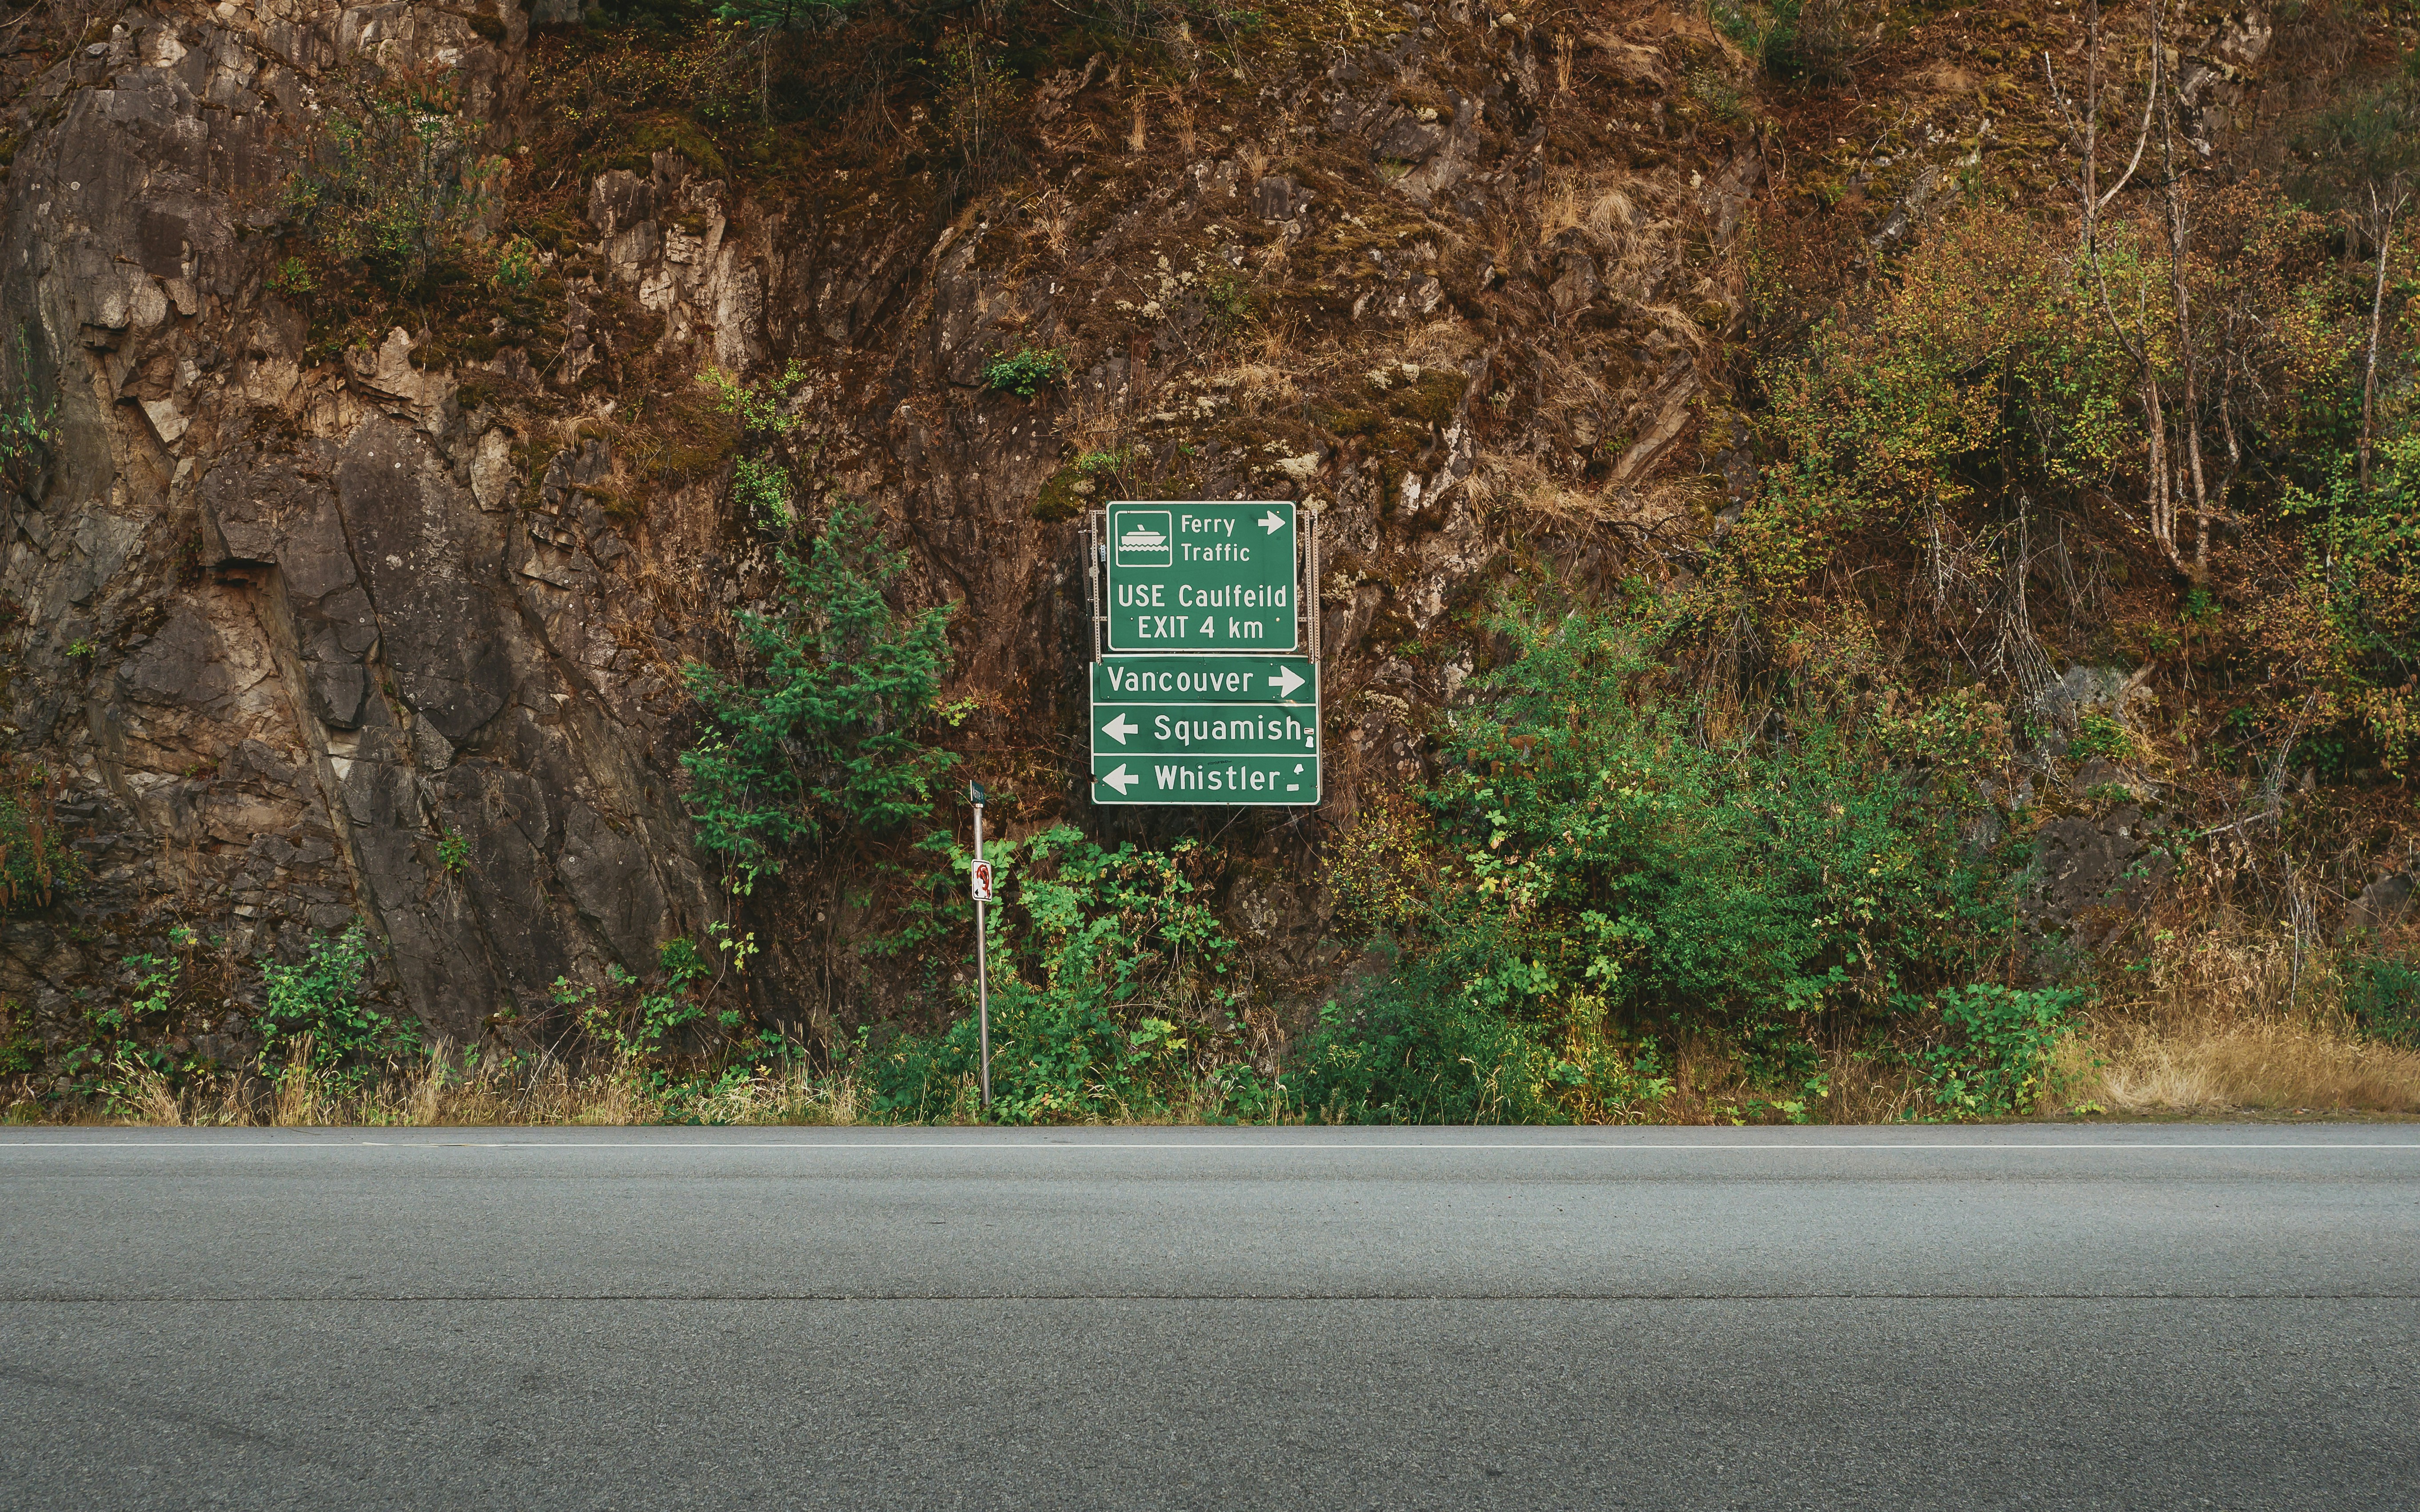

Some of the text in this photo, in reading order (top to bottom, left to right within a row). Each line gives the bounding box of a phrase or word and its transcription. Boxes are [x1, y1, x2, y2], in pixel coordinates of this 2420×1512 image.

[1181, 514, 1235, 537] Ferry
[1181, 543, 1250, 561] Traffic
[1119, 584, 1286, 607] USE Caulfeild
[1138, 616, 1263, 638] EXIT 4 km
[1107, 666, 1254, 692] Vancouver
[1154, 715, 1301, 747] Squamish
[1154, 764, 1280, 791] Whistler
